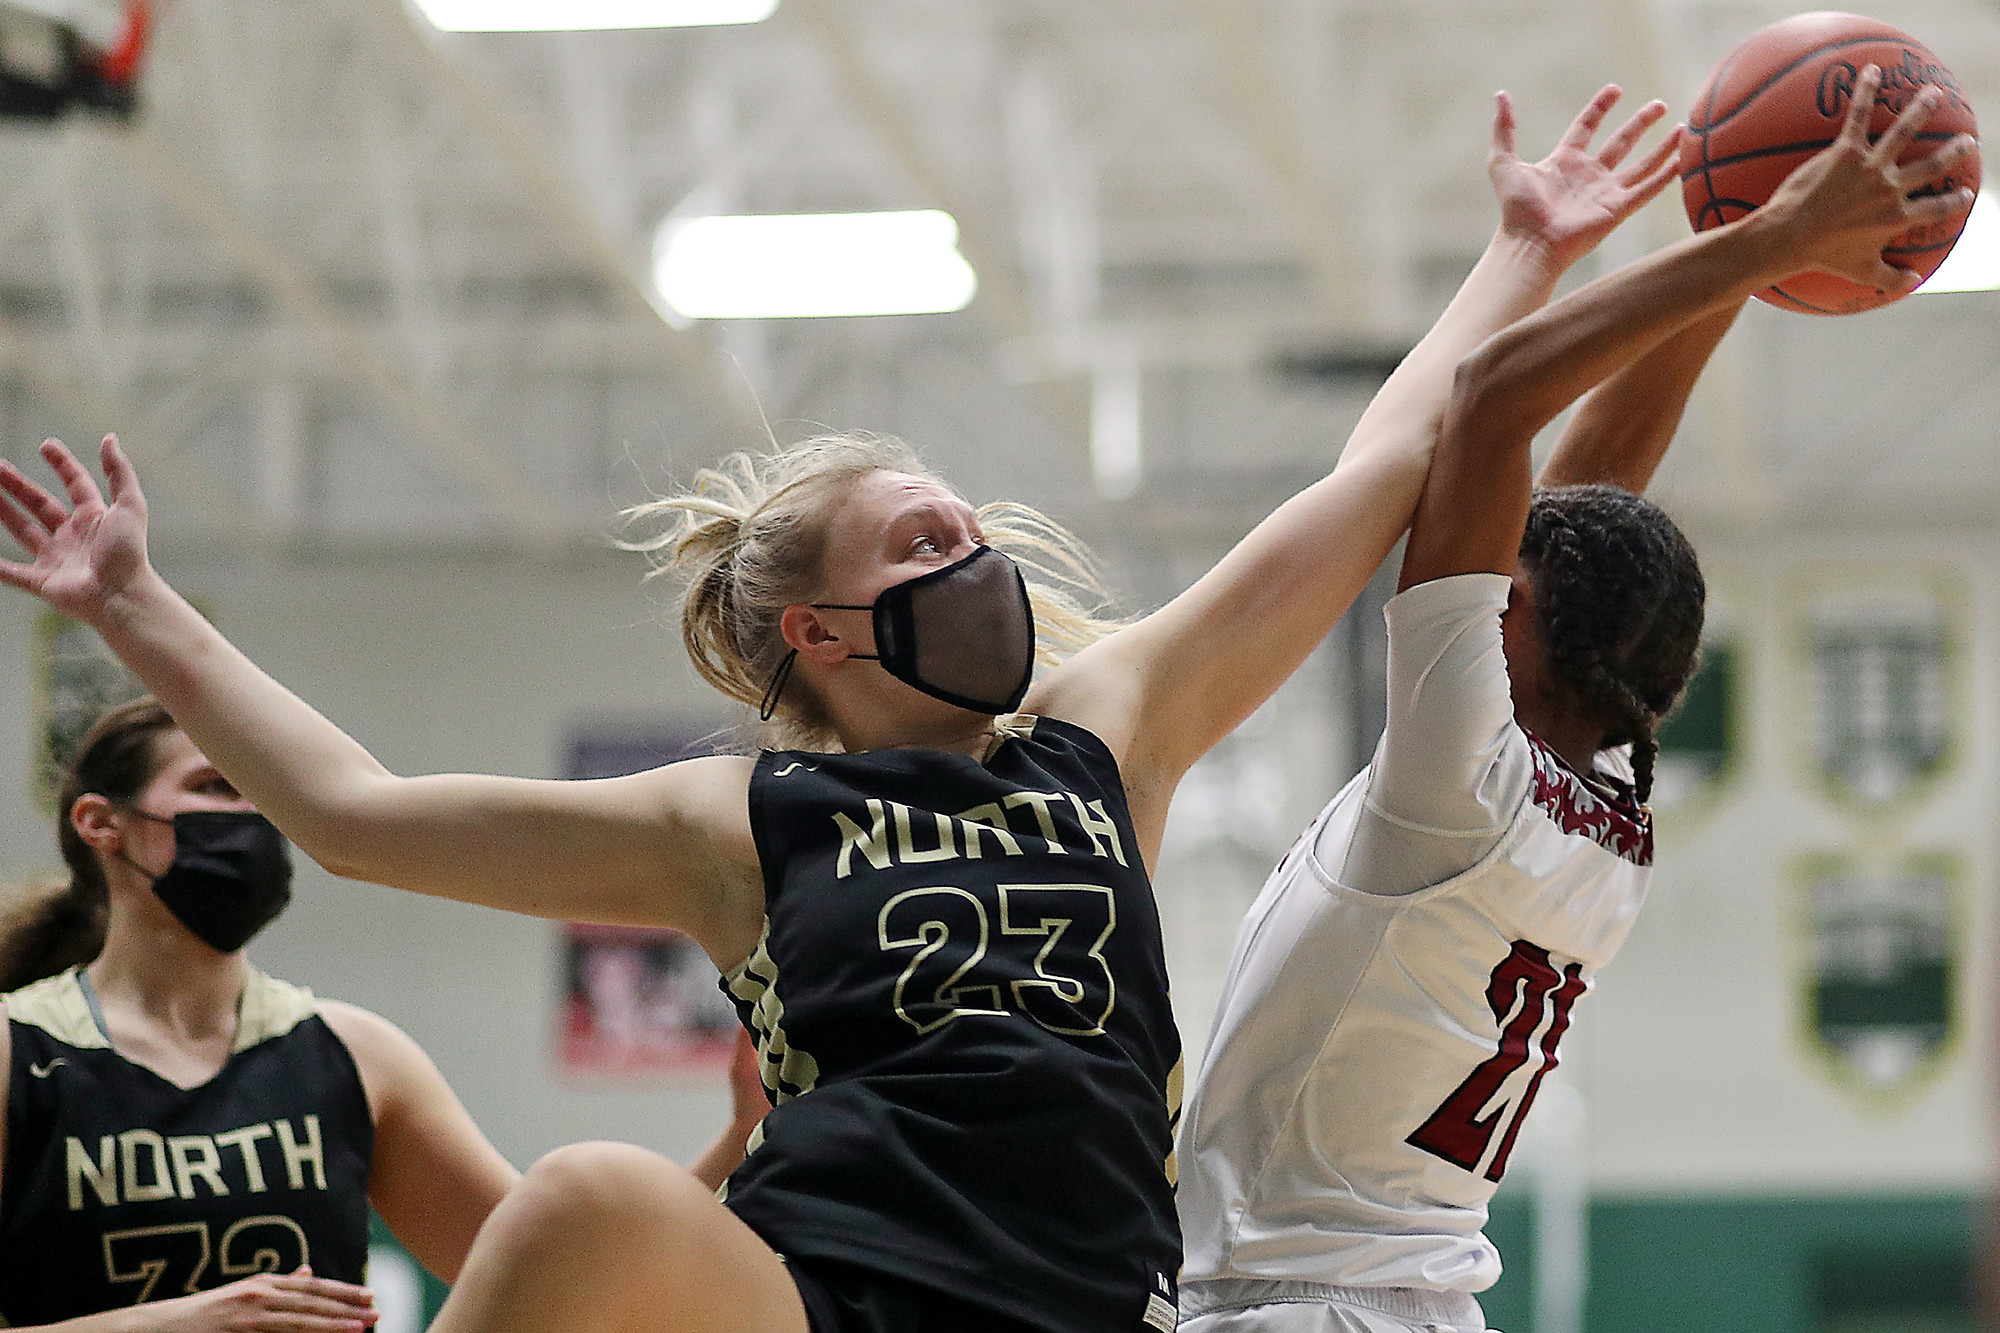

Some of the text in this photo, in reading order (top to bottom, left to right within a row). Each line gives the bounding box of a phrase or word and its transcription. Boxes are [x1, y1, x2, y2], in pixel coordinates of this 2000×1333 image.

[831, 791, 1129, 879] NORTH
[877, 883, 1116, 1036] 23
[1404, 938, 1587, 1184] 21
[65, 1114, 328, 1211] NORTH
